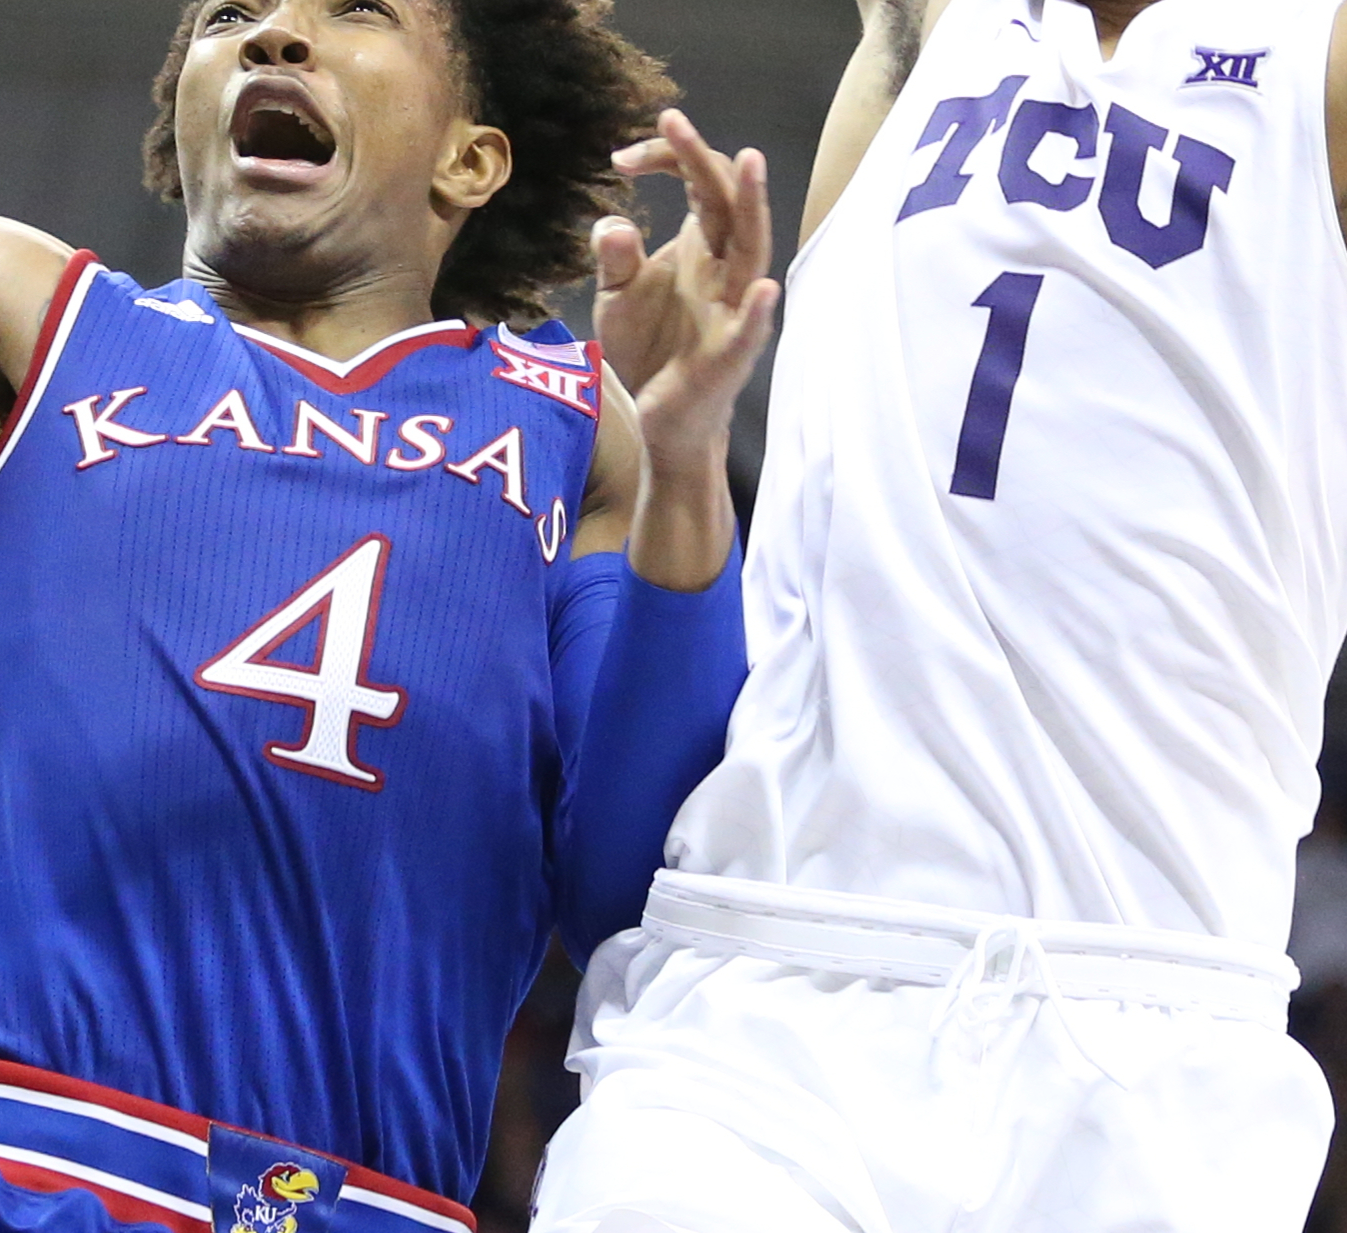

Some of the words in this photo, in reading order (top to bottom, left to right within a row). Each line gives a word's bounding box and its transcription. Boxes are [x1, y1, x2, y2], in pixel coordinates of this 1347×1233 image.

[1185, 46, 1266, 88] XII
[895, 75, 1236, 270] TCU
[495, 346, 593, 412] XII
[949, 271, 1044, 501] 1
[62, 386, 566, 564] KANSAS
[193, 532, 409, 792] 4
[255, 1205, 277, 1225] KU
